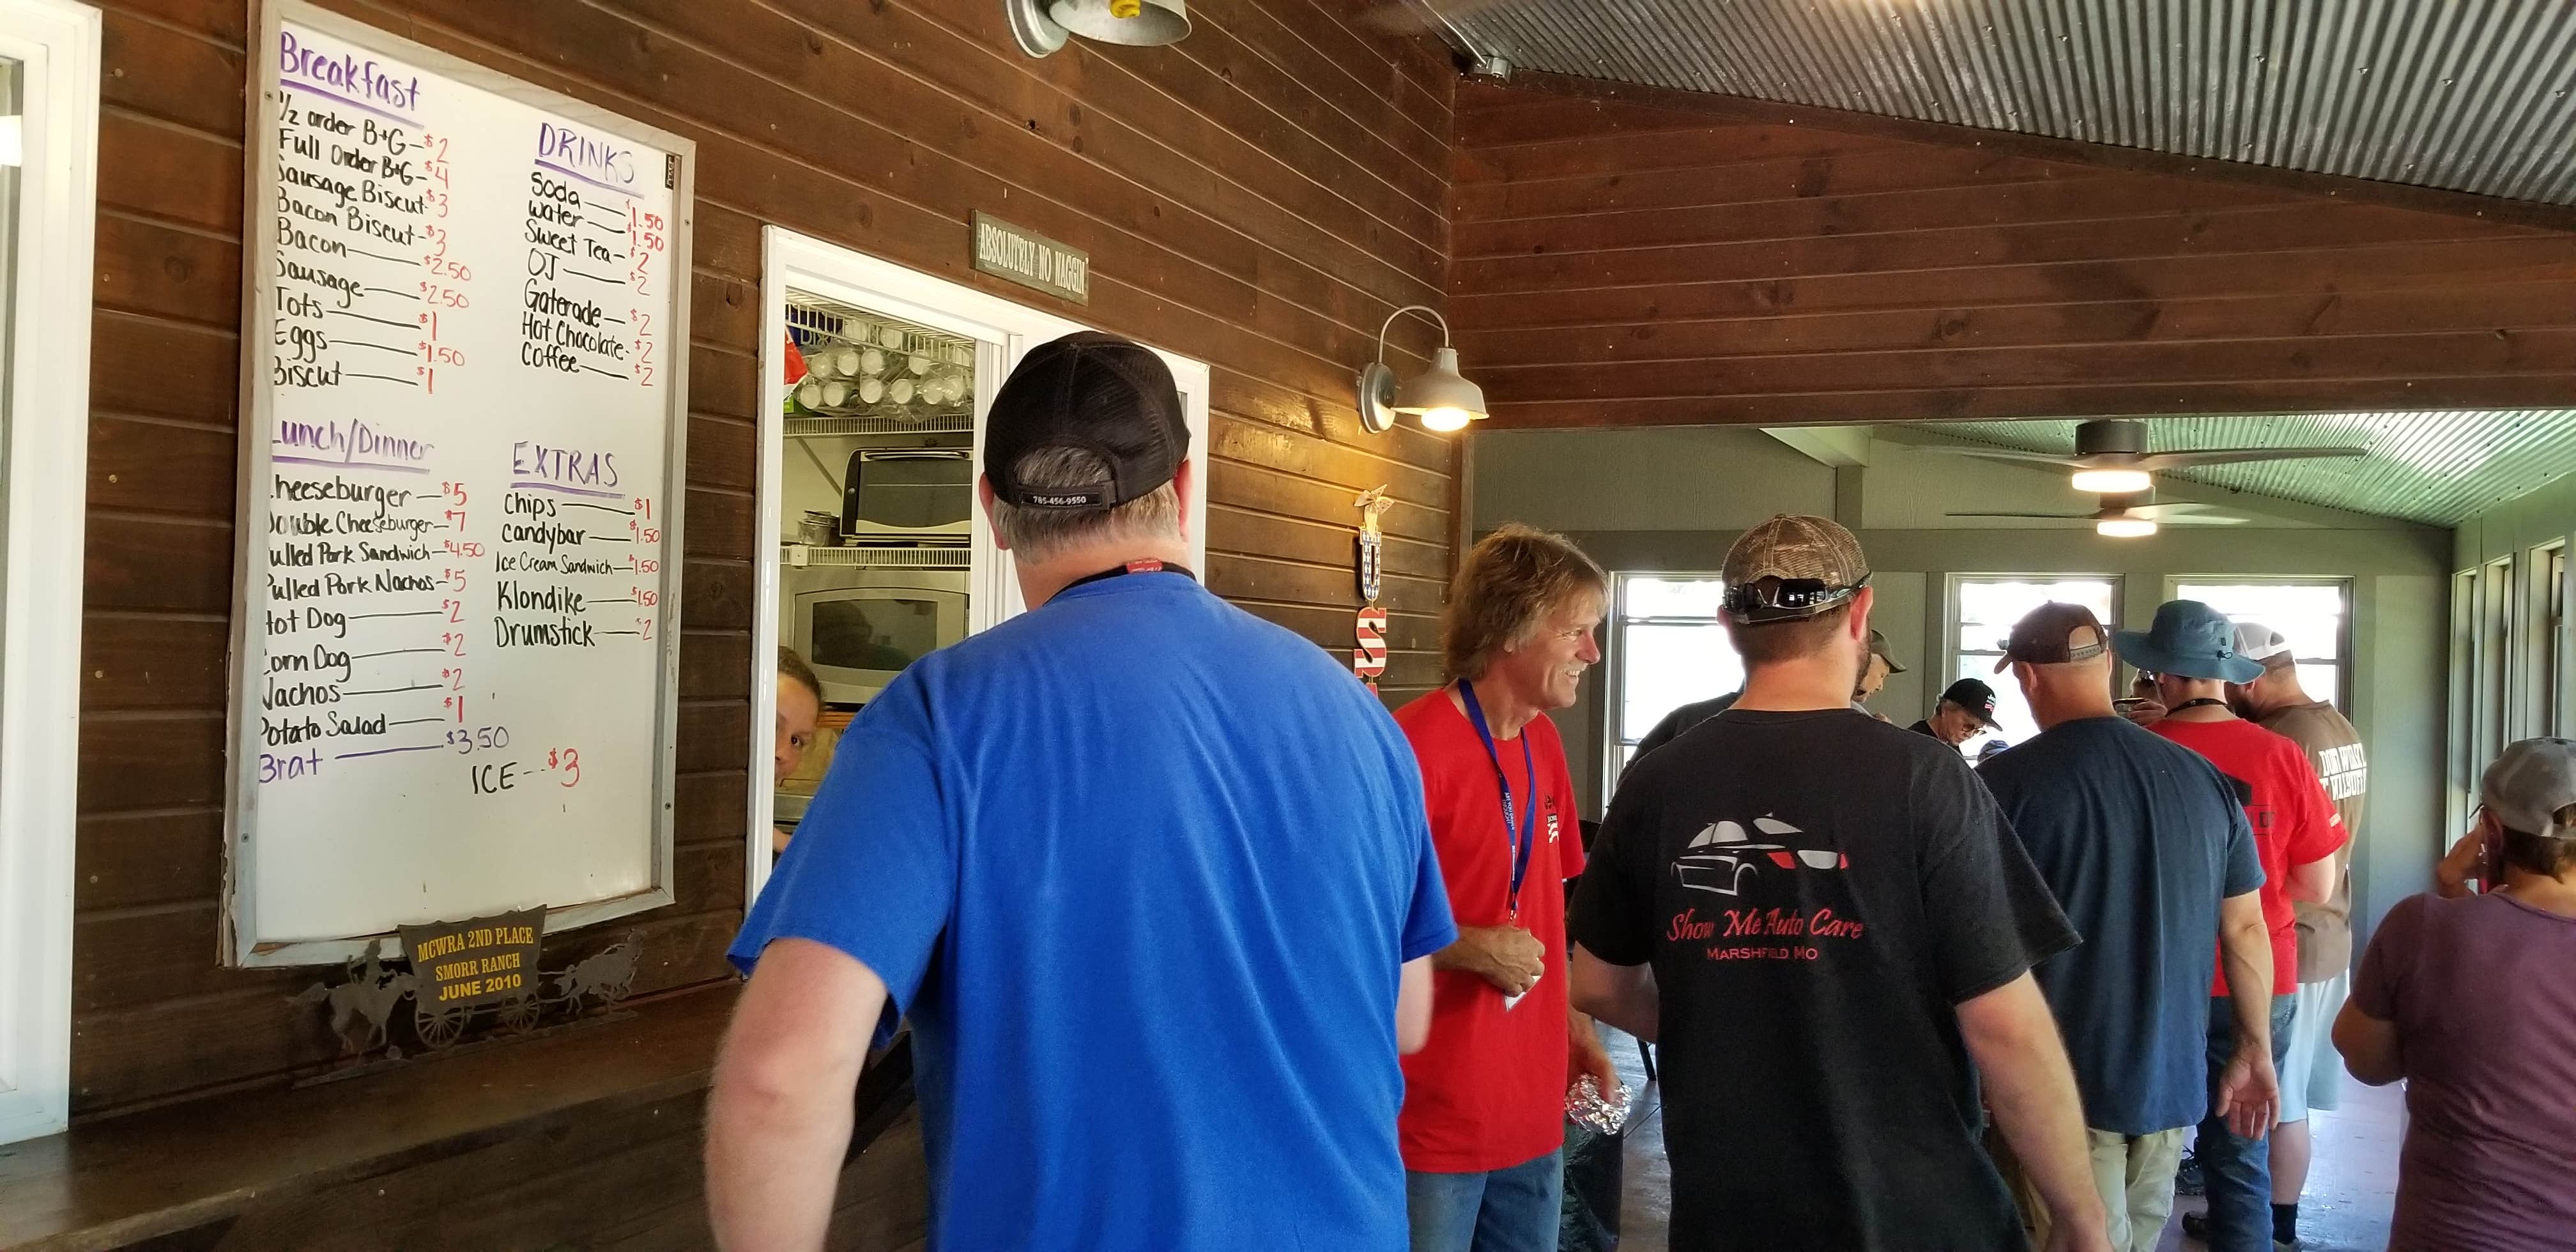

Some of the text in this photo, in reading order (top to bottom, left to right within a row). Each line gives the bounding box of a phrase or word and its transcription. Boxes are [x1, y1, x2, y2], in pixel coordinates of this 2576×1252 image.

[280, 31, 421, 111] Breakfast
[279, 128, 319, 160] Full
[424, 160, 449, 190] $4
[424, 134, 449, 164] $2
[539, 122, 634, 184] DRINKS
[362, 179, 425, 215] Biscut
[426, 189, 448, 218] $3
[531, 172, 581, 209] Soda
[278, 186, 446, 256] Bacon Biscut $3
[277, 217, 471, 281] Bacon $2.50
[525, 218, 649, 274] Sweet Tea $2
[979, 223, 1035, 277] ABSOLUTELY
[1038, 244, 1052, 282] NO
[276, 250, 470, 309] Sausage $2.50
[528, 248, 650, 296] OJ $2
[276, 286, 437, 341] Tots $1
[524, 278, 652, 336] Gaterade $2
[275, 319, 465, 367] Eggs $1.50
[522, 311, 653, 363] Hot Chocolate $2
[417, 367, 434, 394] $1
[521, 341, 654, 386] Coffee $2
[272, 418, 434, 464] unch/Dinner
[513, 440, 618, 487] EXTRAS
[270, 474, 468, 519] heeseburger $5
[634, 498, 651, 520] $1
[1032, 494, 1087, 505] 785-456-9550
[336, 510, 434, 542] Cheeseburger
[445, 509, 466, 533] $7
[629, 519, 661, 544] $1.50
[268, 539, 486, 567] ulled Pork Sandwich $4.50
[495, 551, 659, 576] Ice Cream Sandwich $1.50
[325, 572, 372, 596] Pork
[376, 569, 434, 593] Nachos
[443, 569, 466, 592] $5
[497, 580, 658, 615] Klondike $1.50
[307, 607, 346, 638] Dog
[441, 599, 465, 623] $2
[494, 616, 652, 648] Drumstick $2
[263, 632, 466, 682] orn Dog $2
[441, 668, 466, 691] $2
[326, 710, 386, 737] Salad
[443, 696, 463, 723] $1
[259, 726, 509, 784] Brat $3.50
[471, 747, 580, 794] ICE $3
[417, 927, 534, 963] MCWRA 2ND PLACE
[1667, 907, 1865, 942] Show Me Auto Care
[436, 953, 520, 981] SMORR RANCH
[1793, 946, 1818, 960] MO
[439, 973, 521, 1002] JUNE 2010
